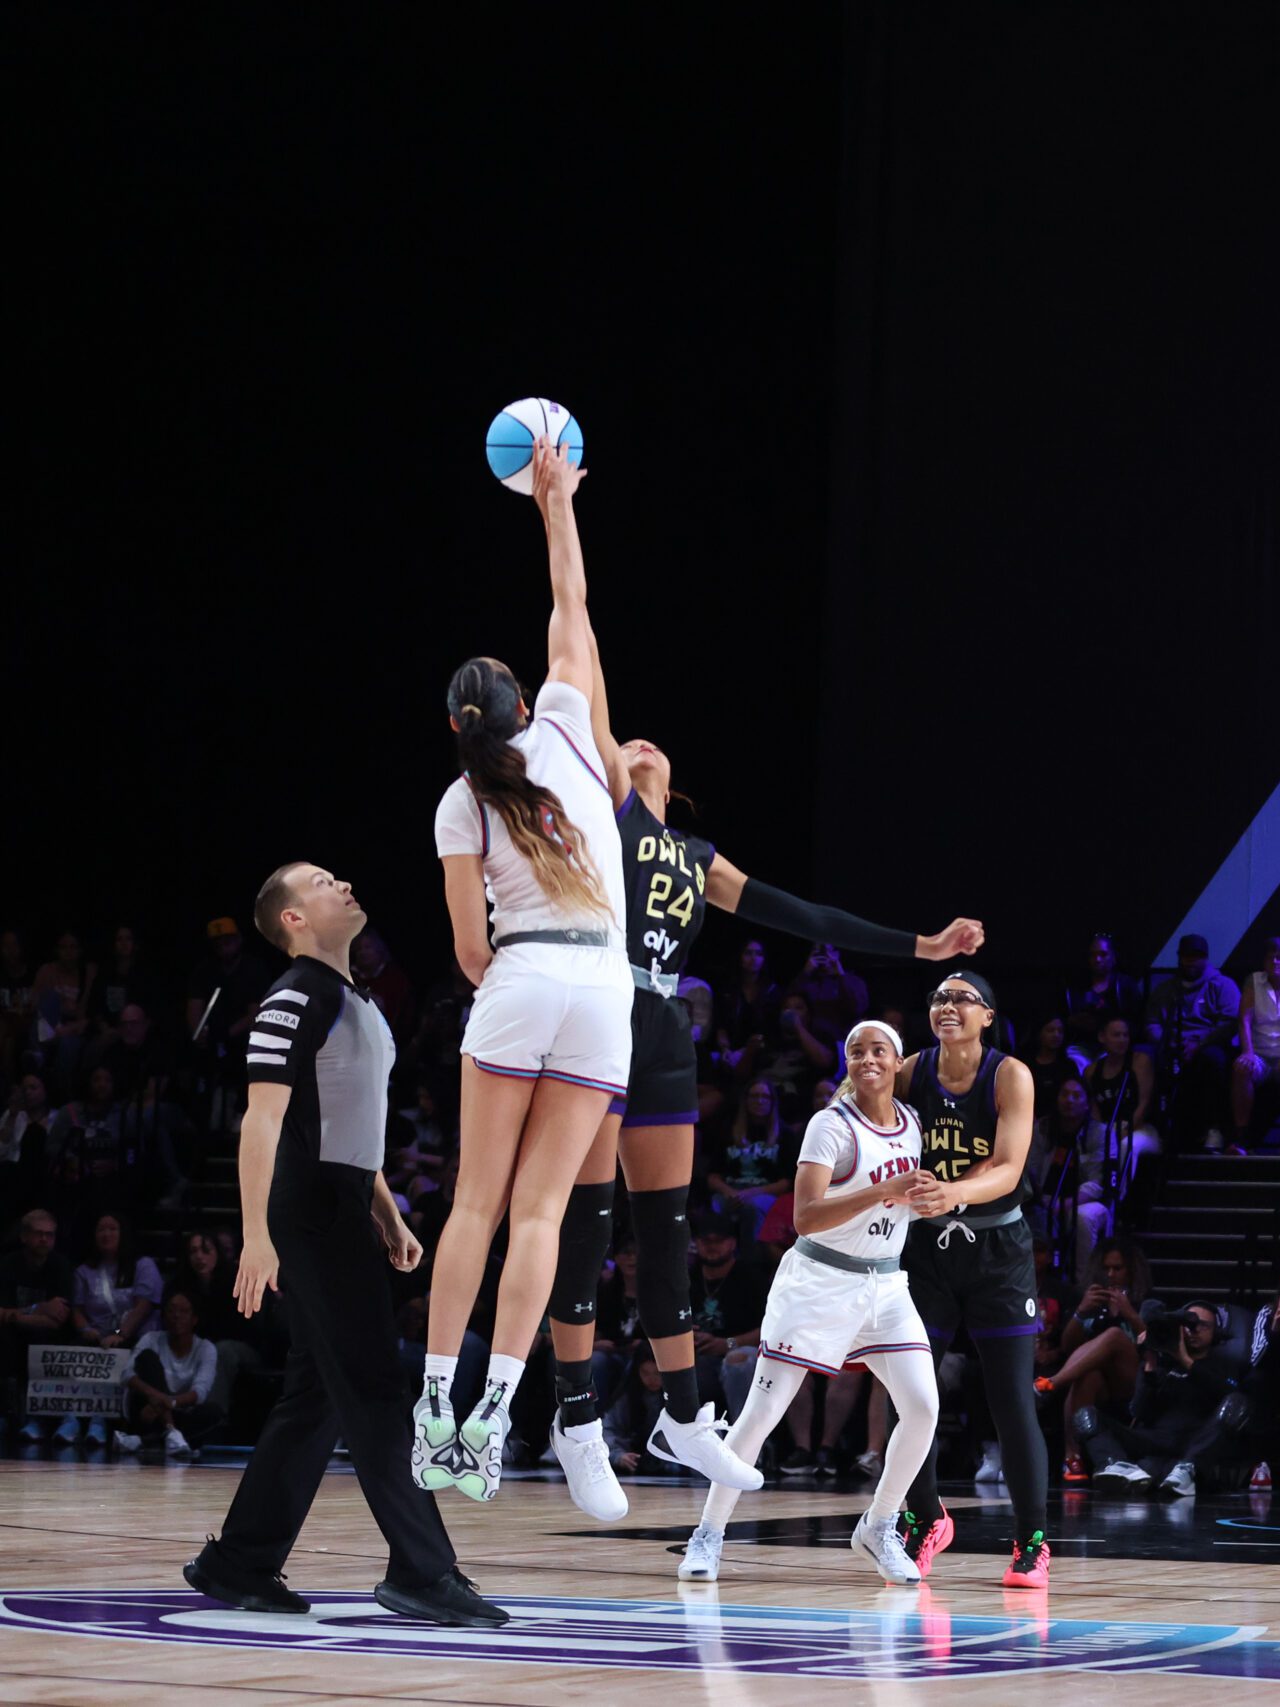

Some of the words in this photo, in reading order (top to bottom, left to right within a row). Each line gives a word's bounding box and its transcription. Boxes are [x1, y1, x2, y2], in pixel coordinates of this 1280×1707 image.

[637, 835, 705, 896] OWLS
[646, 872, 695, 928] 24
[935, 1117, 964, 1129] LUNAR
[868, 1217, 896, 1241] ally
[41, 1350, 117, 1366] EVERYONE
[43, 1364, 113, 1380] WATCHES
[29, 1396, 123, 1413] BASKETBALL
